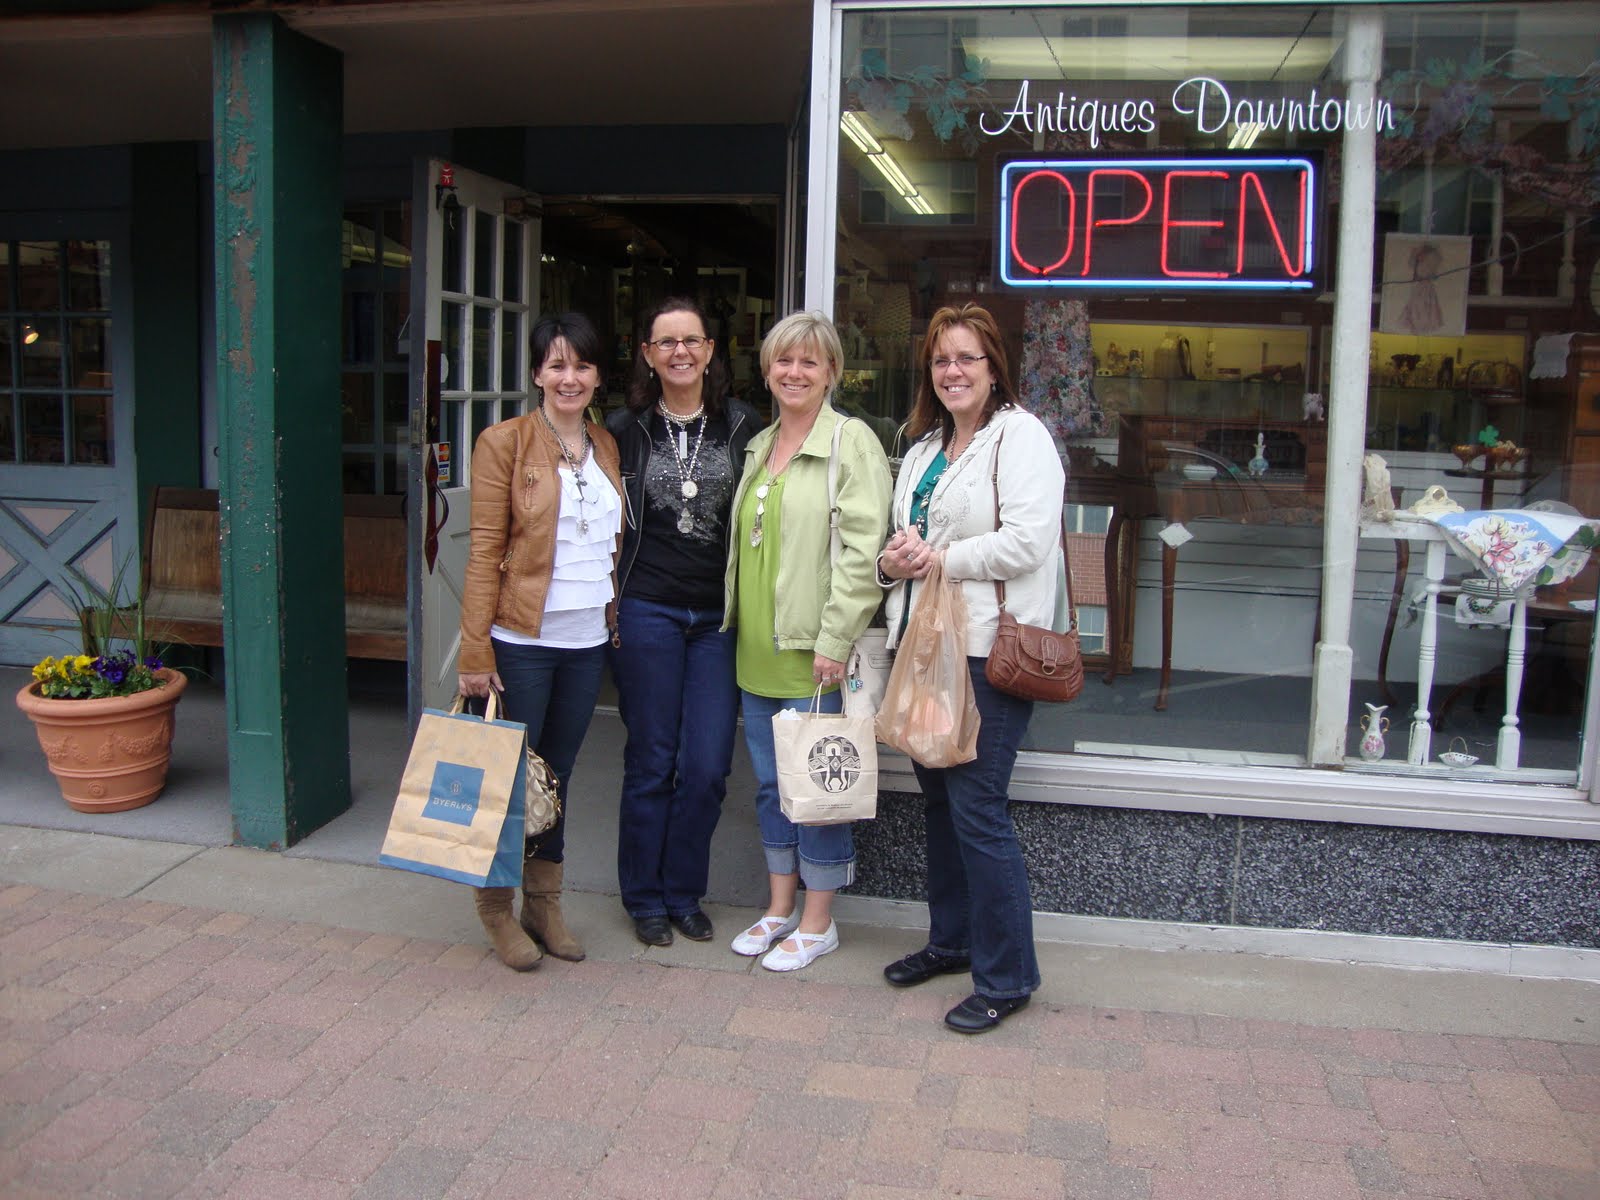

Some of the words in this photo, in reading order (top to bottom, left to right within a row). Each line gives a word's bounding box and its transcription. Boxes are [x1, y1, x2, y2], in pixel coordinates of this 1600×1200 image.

[979, 80, 1156, 149] Antiques
[1172, 77, 1396, 134] Downtown
[1011, 169, 1308, 277] OPEN
